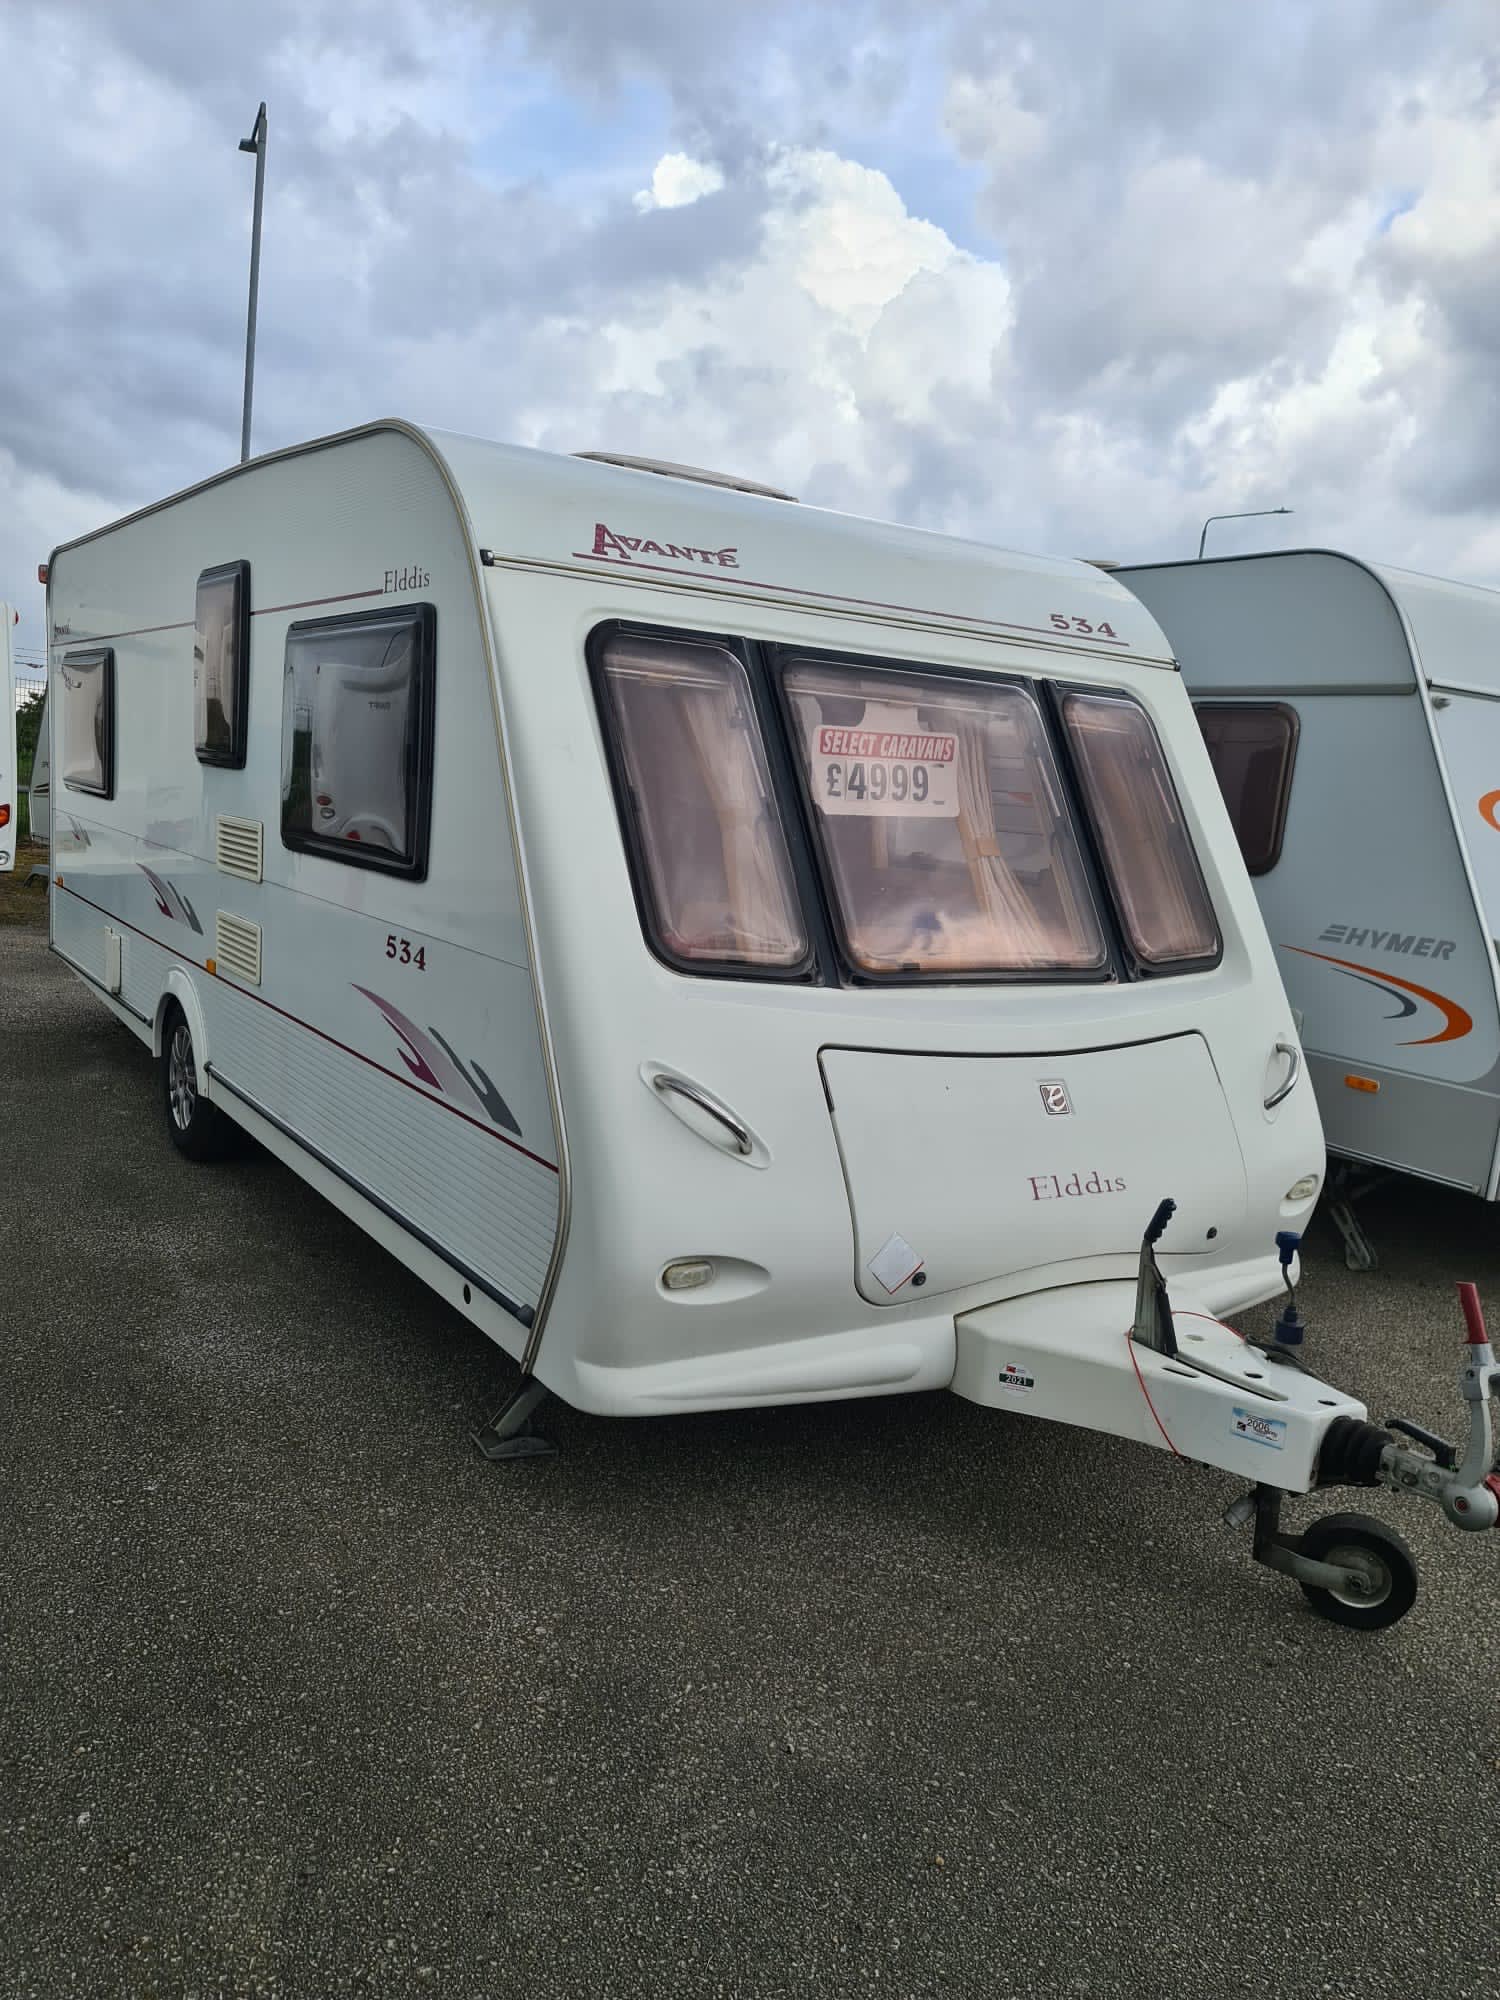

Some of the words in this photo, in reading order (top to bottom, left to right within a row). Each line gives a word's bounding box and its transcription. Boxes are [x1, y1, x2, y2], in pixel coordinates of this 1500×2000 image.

[384, 566, 430, 593] Elddis
[1050, 614, 1118, 638] 534
[822, 730, 877, 755] SELECT
[879, 736, 953, 760] CARAVANS
[826, 762, 929, 801] £4999
[385, 934, 426, 971] 534
[1344, 926, 1457, 960] HYMER
[1027, 1171, 1127, 1201] Elddis
[1006, 1375, 1027, 1386] 2021
